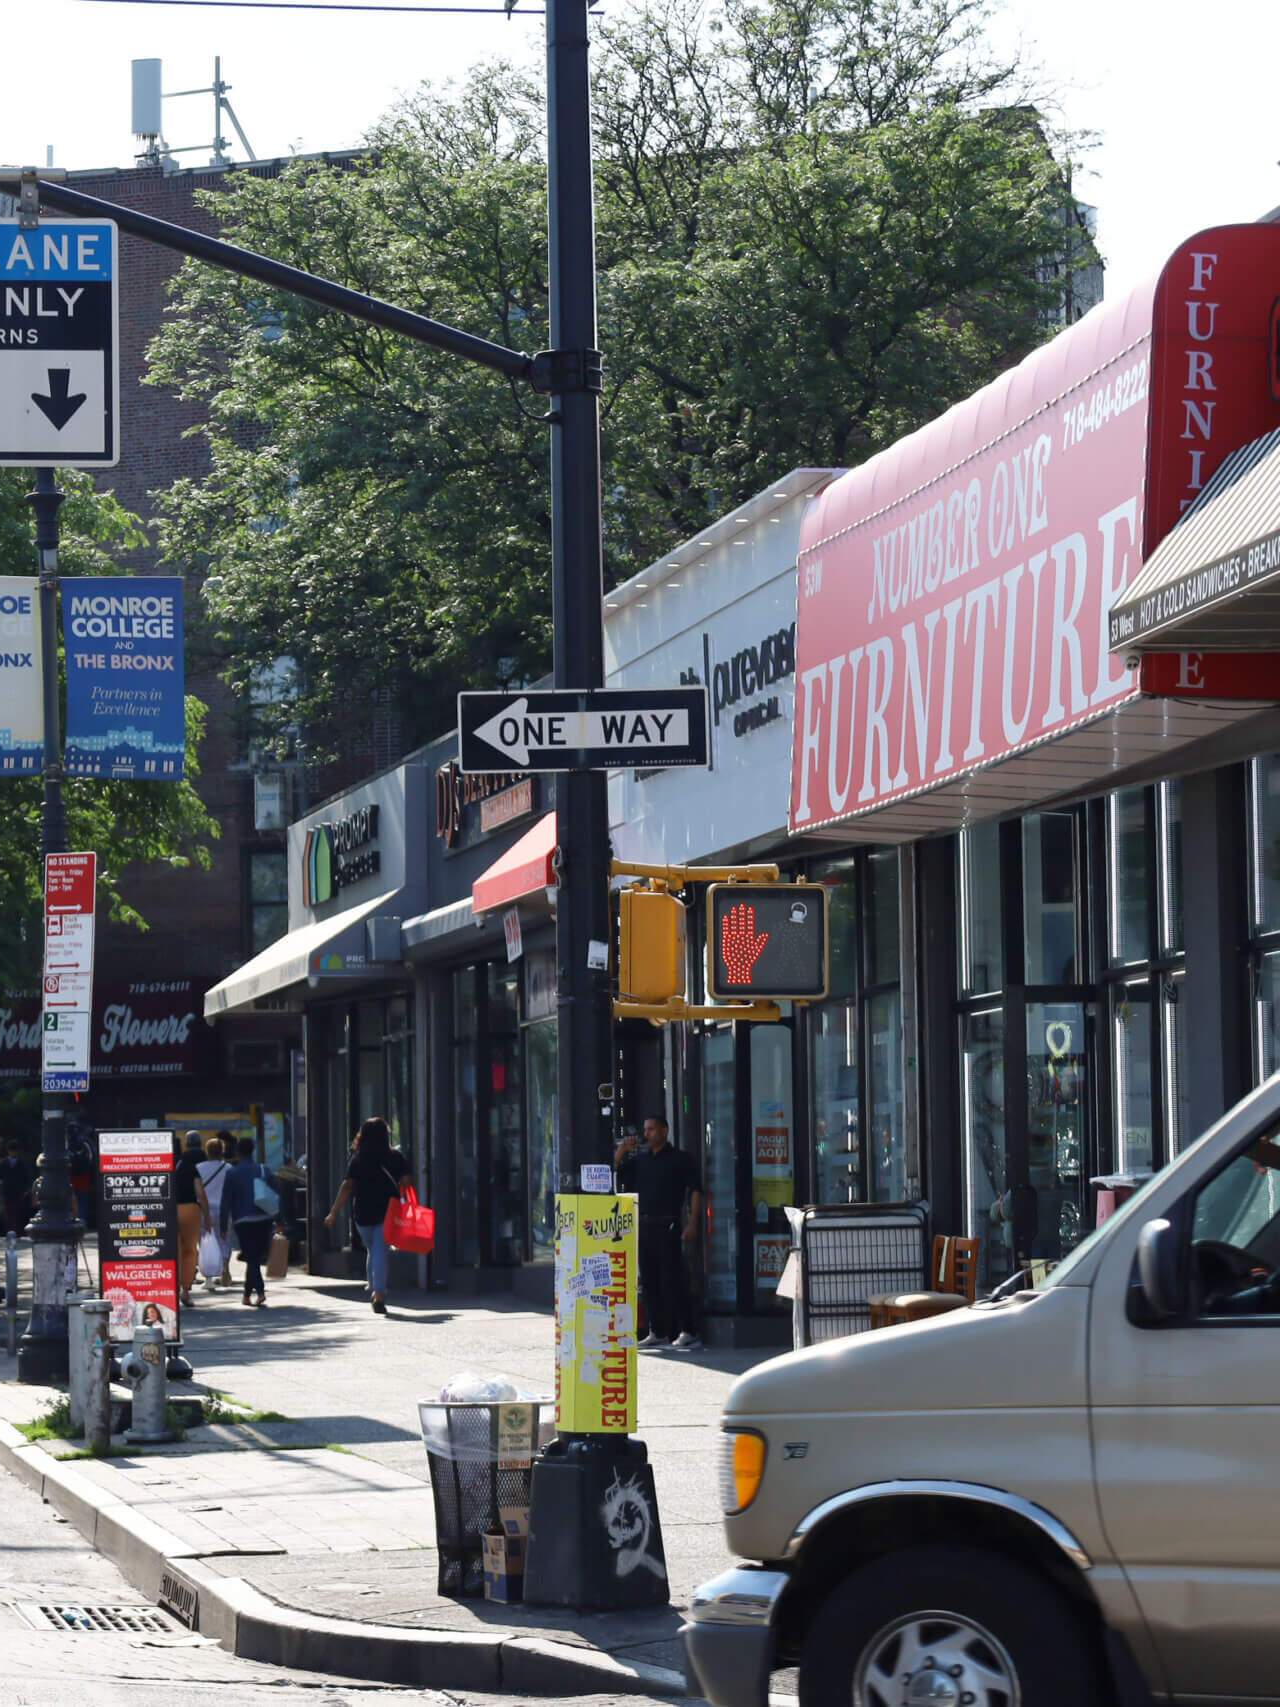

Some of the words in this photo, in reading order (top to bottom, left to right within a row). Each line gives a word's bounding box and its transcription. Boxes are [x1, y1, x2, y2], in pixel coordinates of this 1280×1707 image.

[1063, 359, 1146, 451] 718-484-8222
[868, 476, 980, 624] NUMBER
[988, 434, 1051, 557] ONE
[71, 596, 174, 617] MONROE
[1119, 612, 1135, 639] West
[1140, 596, 1155, 630] HOT
[1156, 595, 1162, 621] &
[1163, 583, 1185, 618] COLD
[1186, 556, 1240, 605] SANDWICHES
[71, 618, 174, 639] COLLEGE
[114, 641, 135, 650] AND
[74, 653, 107, 669] THE
[110, 654, 174, 671] BRONX
[795, 496, 1137, 822] FURNITURE
[91, 686, 147, 702] Partners
[149, 689, 162, 701] in
[92, 701, 161, 716] Excellence
[499, 717, 566, 746] ONE
[601, 714, 673, 744] WAY
[332, 805, 380, 854] PROMPT
[48, 857, 57, 866] NO
[58, 856, 88, 866] STANDING
[47, 1014, 54, 1030] 2
[100, 1003, 197, 1053] Flowers
[44, 1079, 77, 1089] 203943
[106, 1176, 135, 1187] 30%
[139, 1175, 167, 1187] OFF
[105, 1269, 173, 1280] WALGREENS
